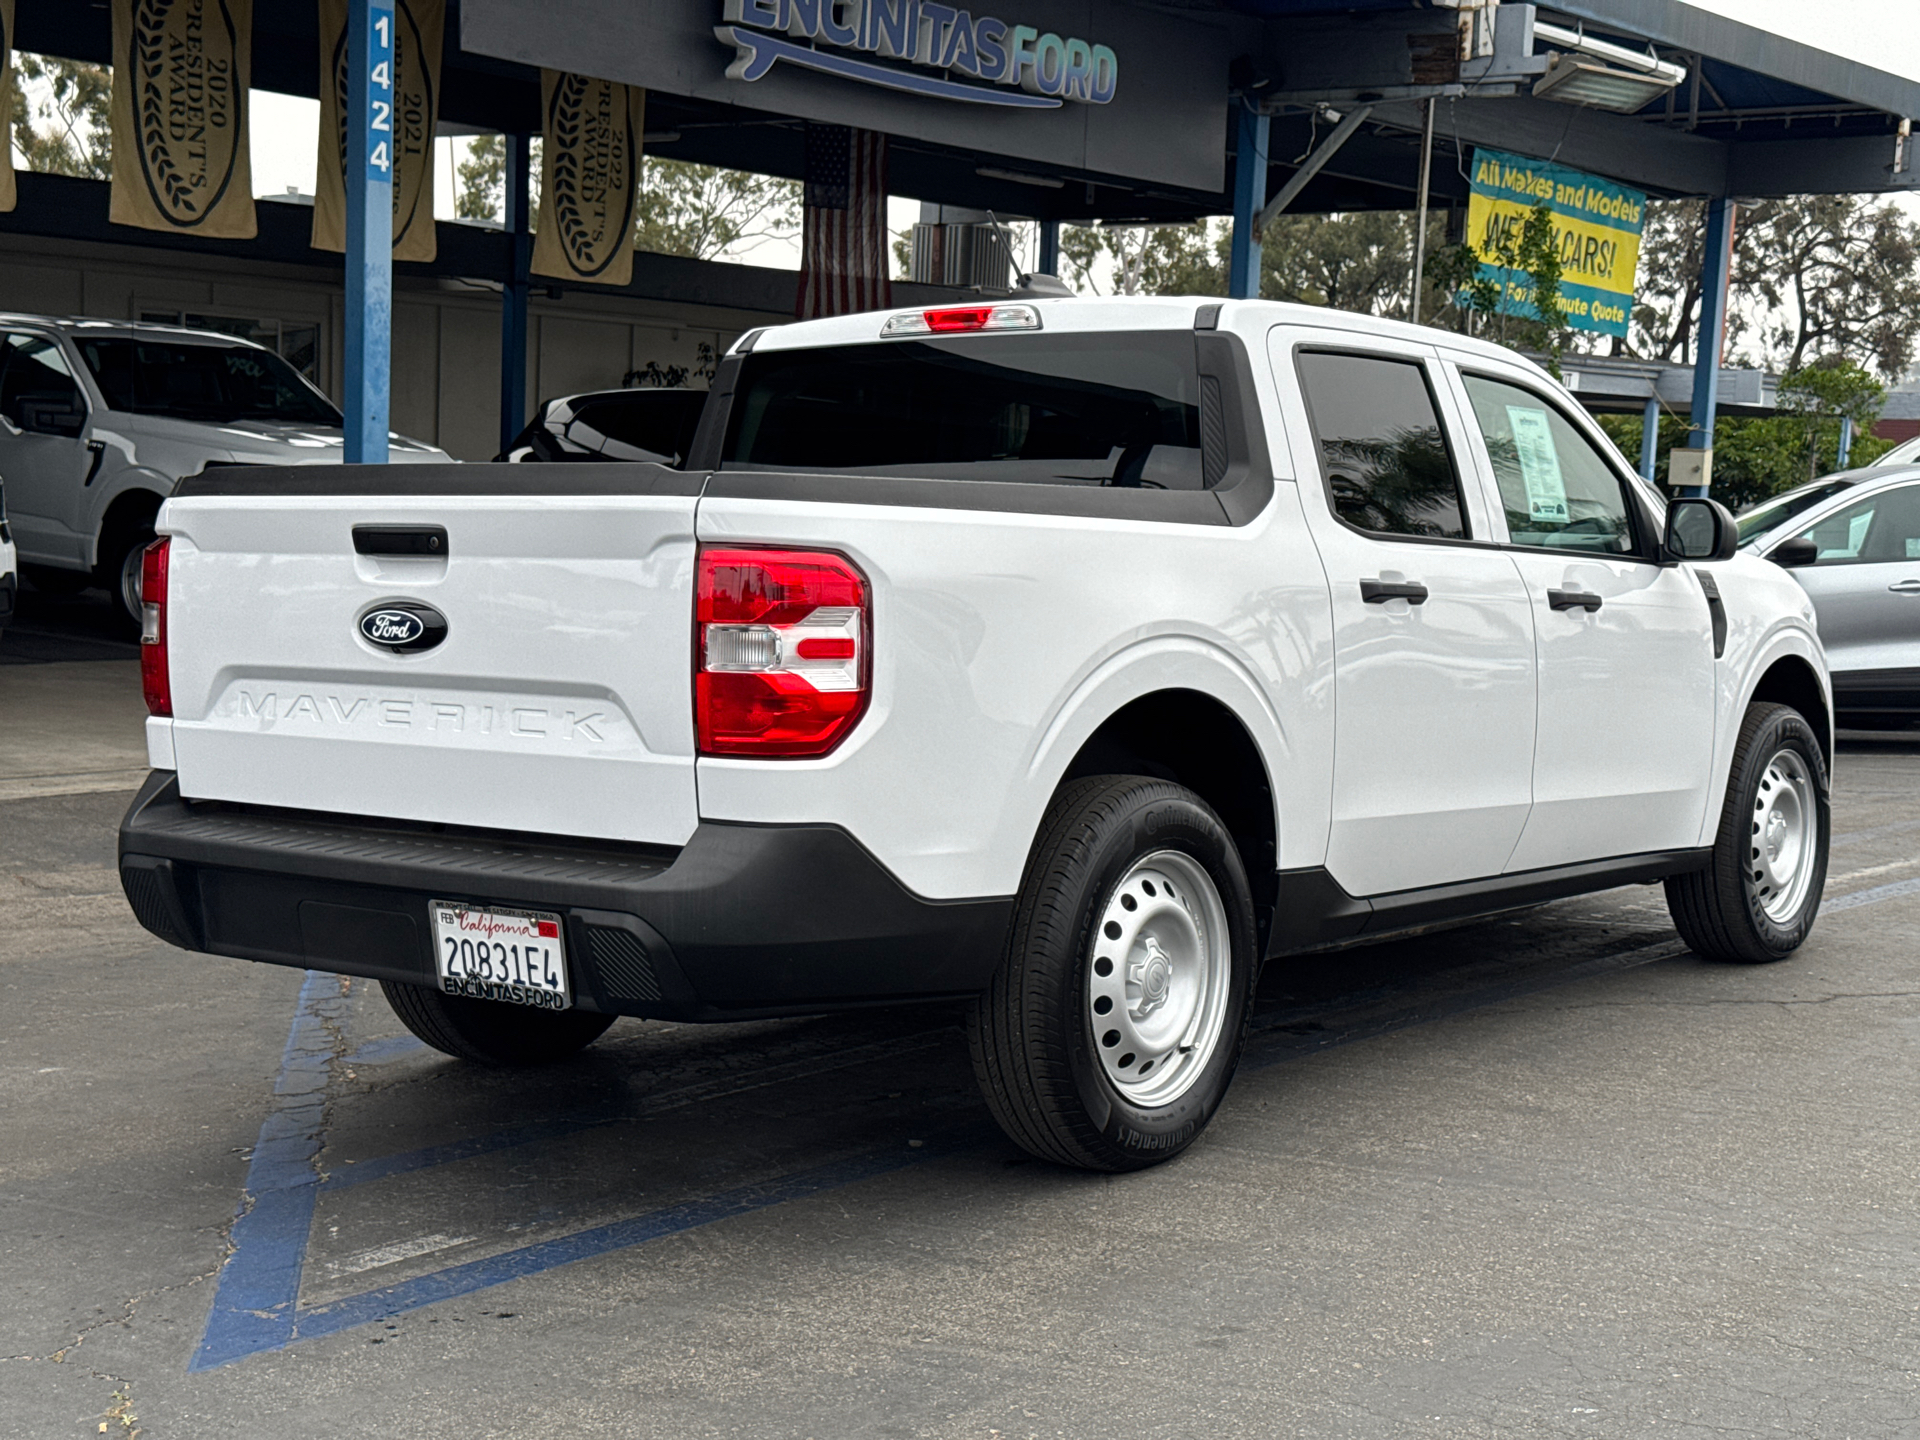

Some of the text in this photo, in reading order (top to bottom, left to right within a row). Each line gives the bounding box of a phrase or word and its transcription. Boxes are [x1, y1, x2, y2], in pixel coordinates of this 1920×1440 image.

[168, 32, 187, 142] AWARD
[1014, 25, 1118, 105] FORD
[206, 57, 229, 129] 2020
[403, 92, 423, 156] 2021
[581, 109, 597, 203] AWARD
[608, 129, 624, 190] 2022
[1475, 160, 1641, 224] All Makes and Models
[1560, 230, 1617, 279] CARS!
[1550, 291, 1588, 316] inute
[1591, 300, 1625, 323] Quote
[372, 614, 410, 639] Ford
[236, 690, 605, 743] MAVERICK
[441, 912, 454, 924] FEB
[460, 910, 539, 939] California
[445, 936, 559, 989] 20831E4
[444, 978, 564, 1009] ENCINITAS FORD
[1124, 1120, 1196, 1152] Continental
